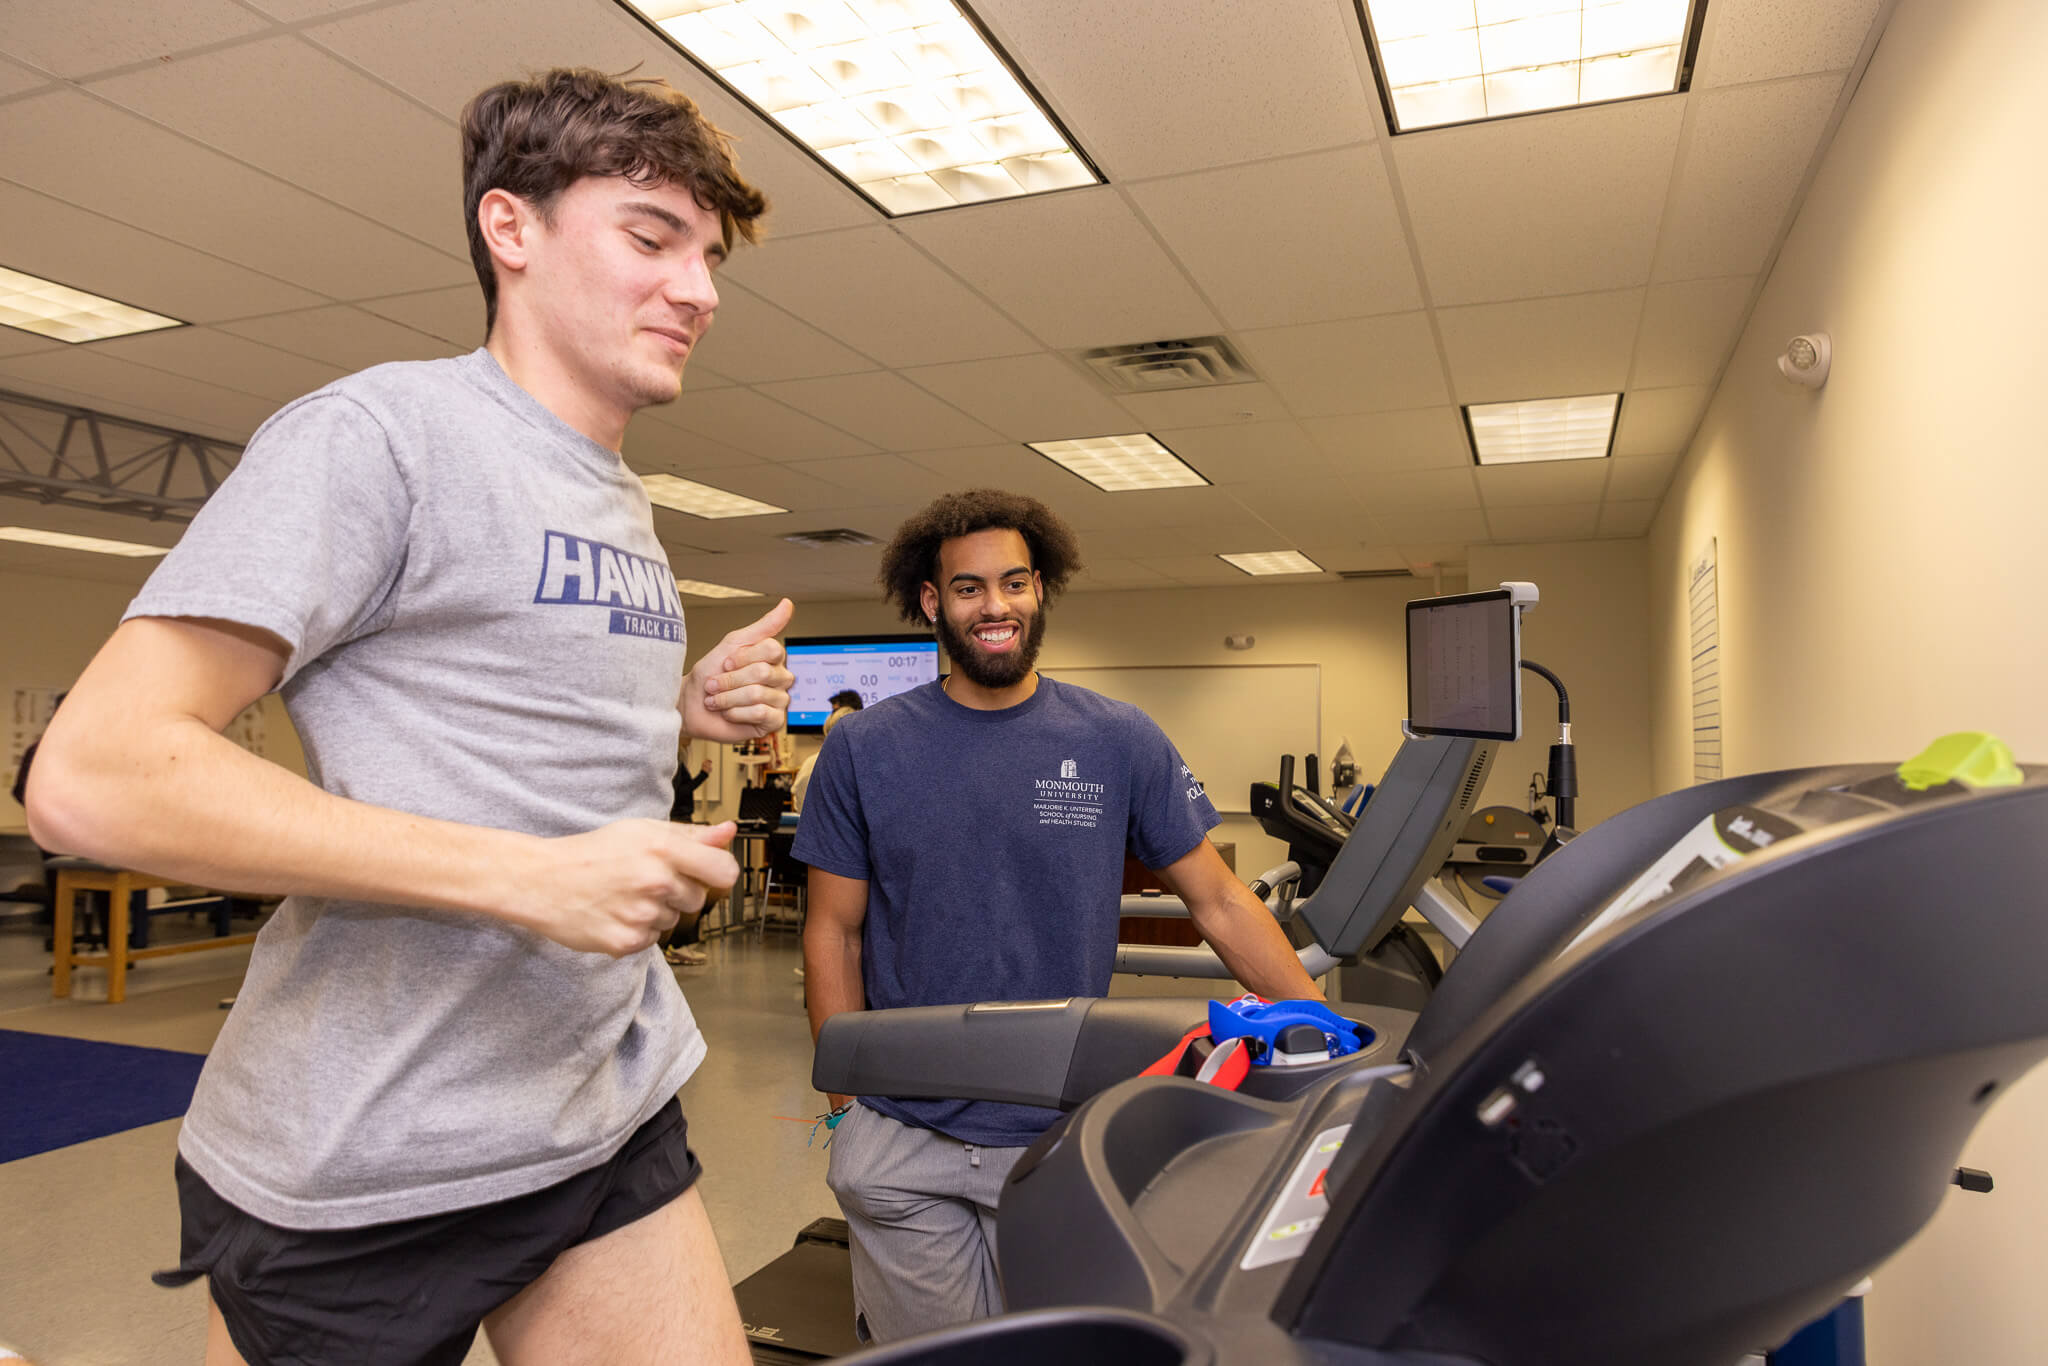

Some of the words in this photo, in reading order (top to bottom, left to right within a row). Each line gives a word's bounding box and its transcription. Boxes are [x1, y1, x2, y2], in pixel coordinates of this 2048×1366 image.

[541, 534, 684, 617] HAWK
[624, 615, 660, 637] TRACK
[664, 624, 671, 639] &
[888, 655, 918, 668] 00:17
[826, 675, 846, 684] VO2
[1035, 780, 1104, 793] MONMOUTH
[1040, 791, 1099, 800] UNIVERSITY
[1069, 806, 1103, 814] UNTERBERG
[1071, 813, 1097, 821] NURSING
[1073, 820, 1096, 828] STUDIES
